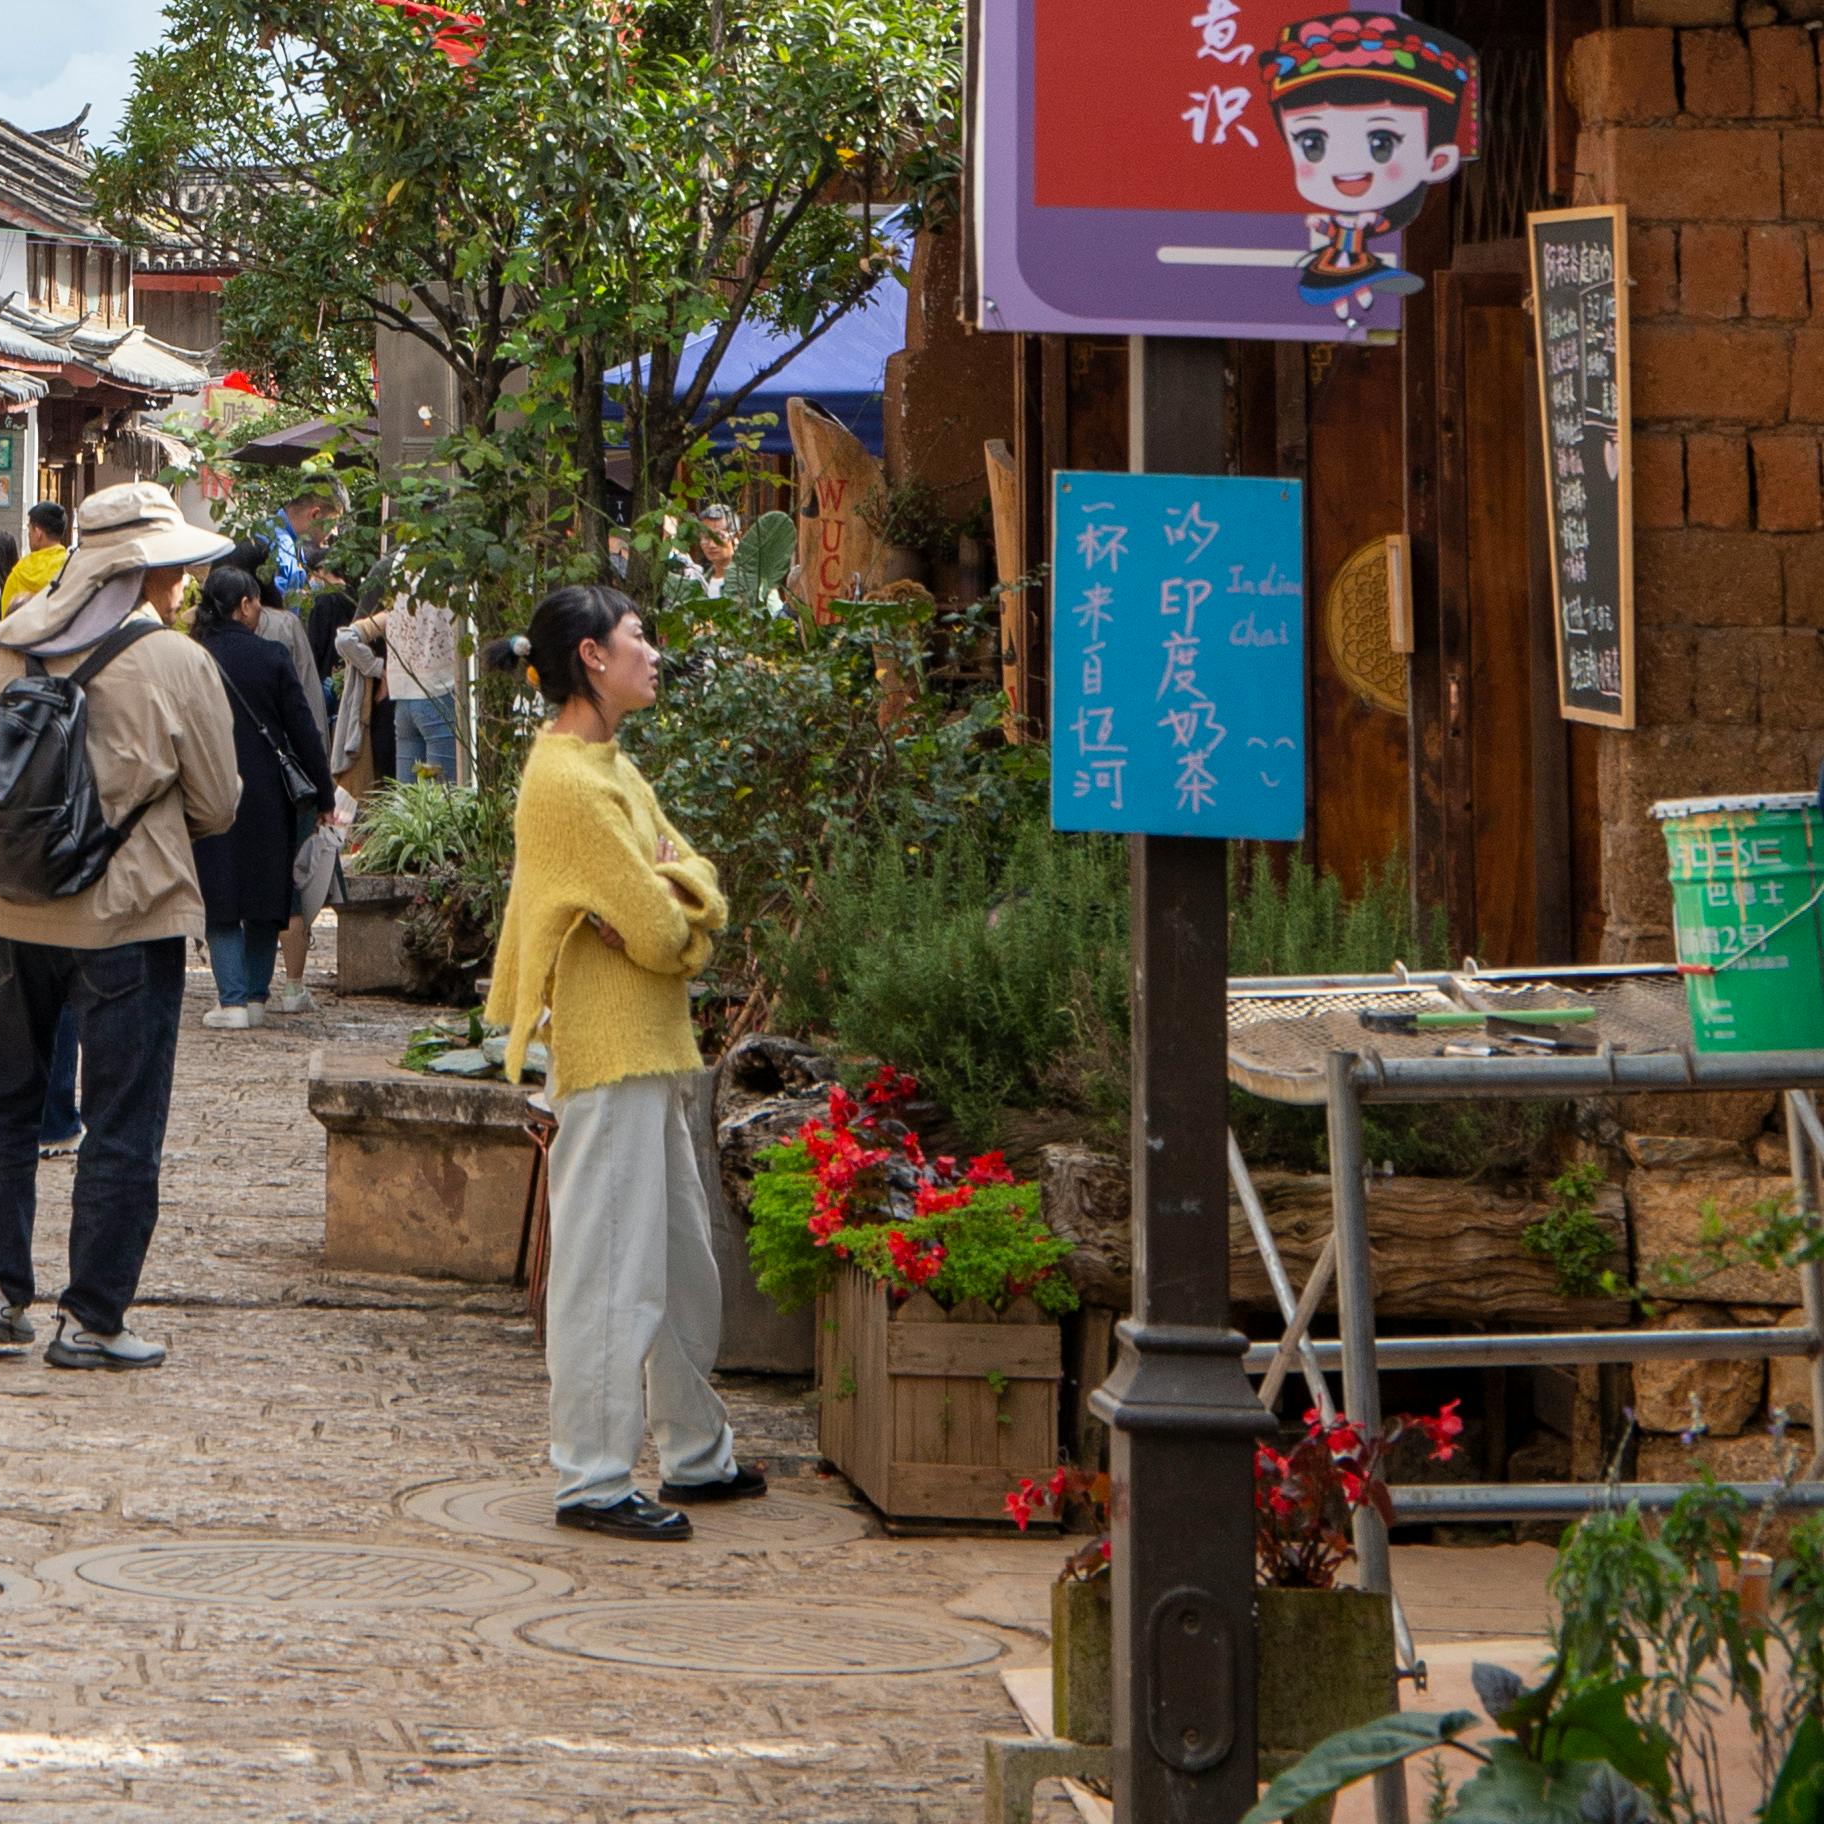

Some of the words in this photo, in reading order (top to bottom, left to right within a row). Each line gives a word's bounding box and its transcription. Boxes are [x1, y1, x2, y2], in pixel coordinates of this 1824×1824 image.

[1155, 501, 1227, 816] 的印度奶茶
